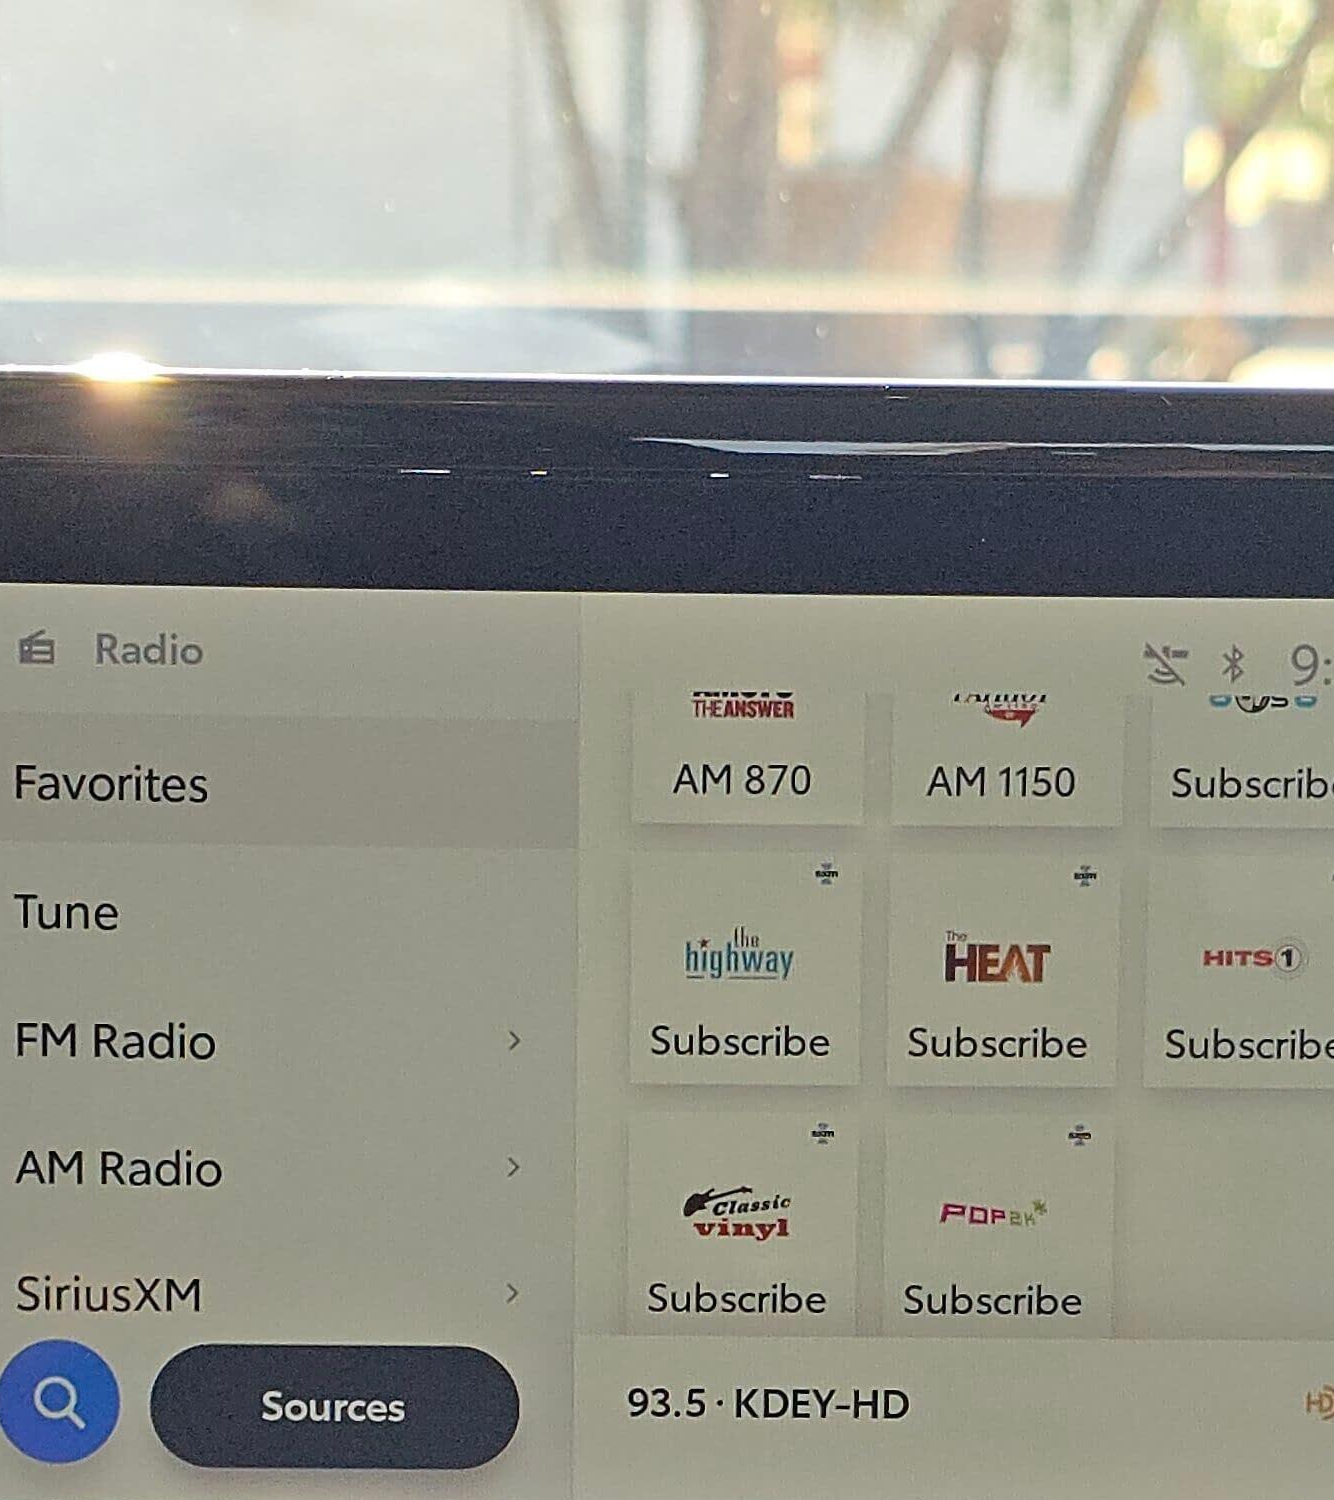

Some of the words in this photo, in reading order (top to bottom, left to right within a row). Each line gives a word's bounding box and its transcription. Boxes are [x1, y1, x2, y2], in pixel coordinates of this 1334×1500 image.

[96, 633, 204, 667] Radio
[15, 764, 209, 804] Favorites
[672, 763, 732, 795] AM
[745, 764, 812, 796] 870
[926, 766, 986, 797] AM
[999, 766, 1075, 798] 1150
[13, 893, 120, 932] Tune
[734, 926, 759, 948] the
[685, 940, 794, 980] highway
[945, 944, 1052, 983] HEAT
[16, 1022, 77, 1058] FM
[94, 1022, 217, 1061] Radio
[651, 1024, 830, 1057] Subscribe
[908, 1026, 1088, 1059] Subscribe
[15, 1150, 84, 1186] AM
[101, 1149, 223, 1188] Radio
[712, 1194, 791, 1216] Classic
[693, 1218, 789, 1241] vinyl
[17, 1275, 201, 1314] SiriusXM
[648, 1282, 827, 1314] Subscribe
[904, 1284, 1083, 1316] Subscribe
[262, 1390, 406, 1423] Sources
[627, 1388, 706, 1419] 93.5
[734, 1388, 910, 1420] KDEY-HD
